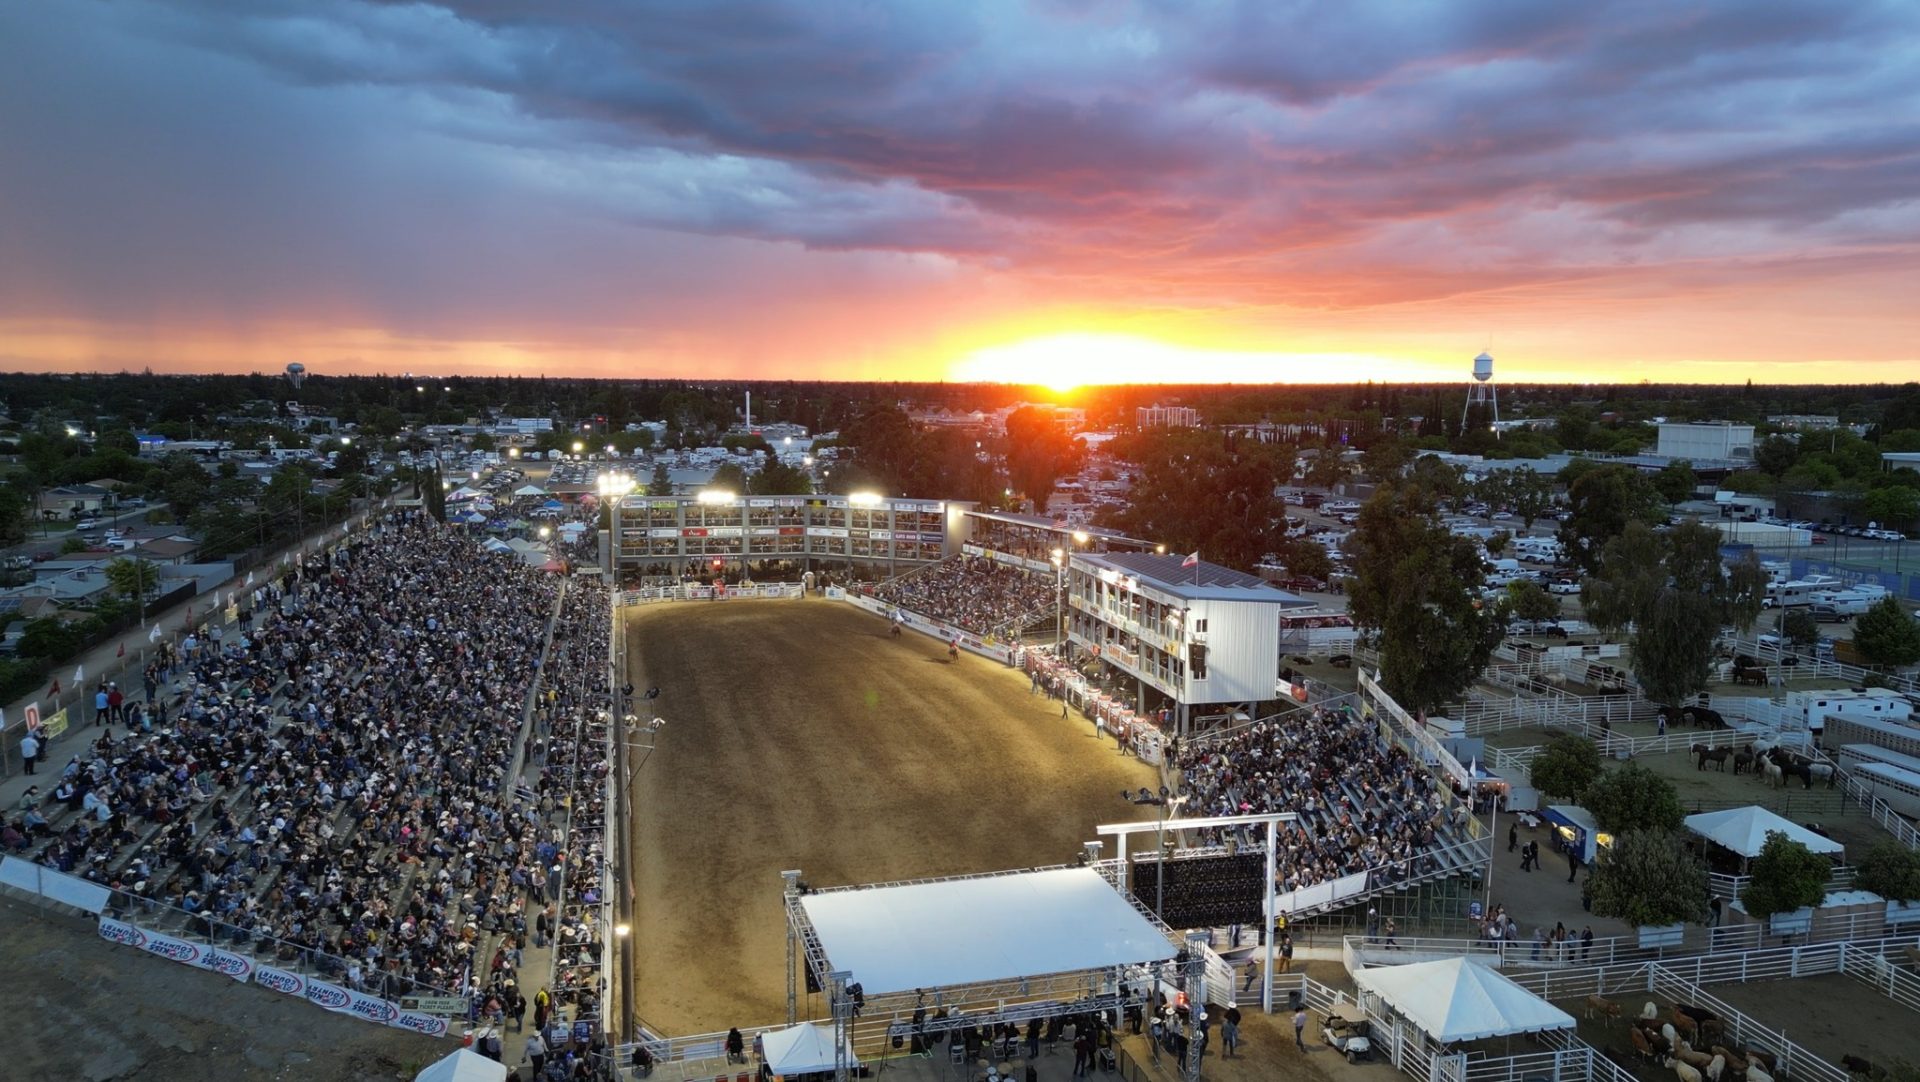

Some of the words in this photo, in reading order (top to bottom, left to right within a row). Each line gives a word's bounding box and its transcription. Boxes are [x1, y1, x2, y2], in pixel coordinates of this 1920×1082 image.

[149, 944, 170, 954] KISS
[153, 940, 192, 952] COUNTRY
[352, 1004, 372, 1014] KISS
[399, 1017, 419, 1028] KISS
